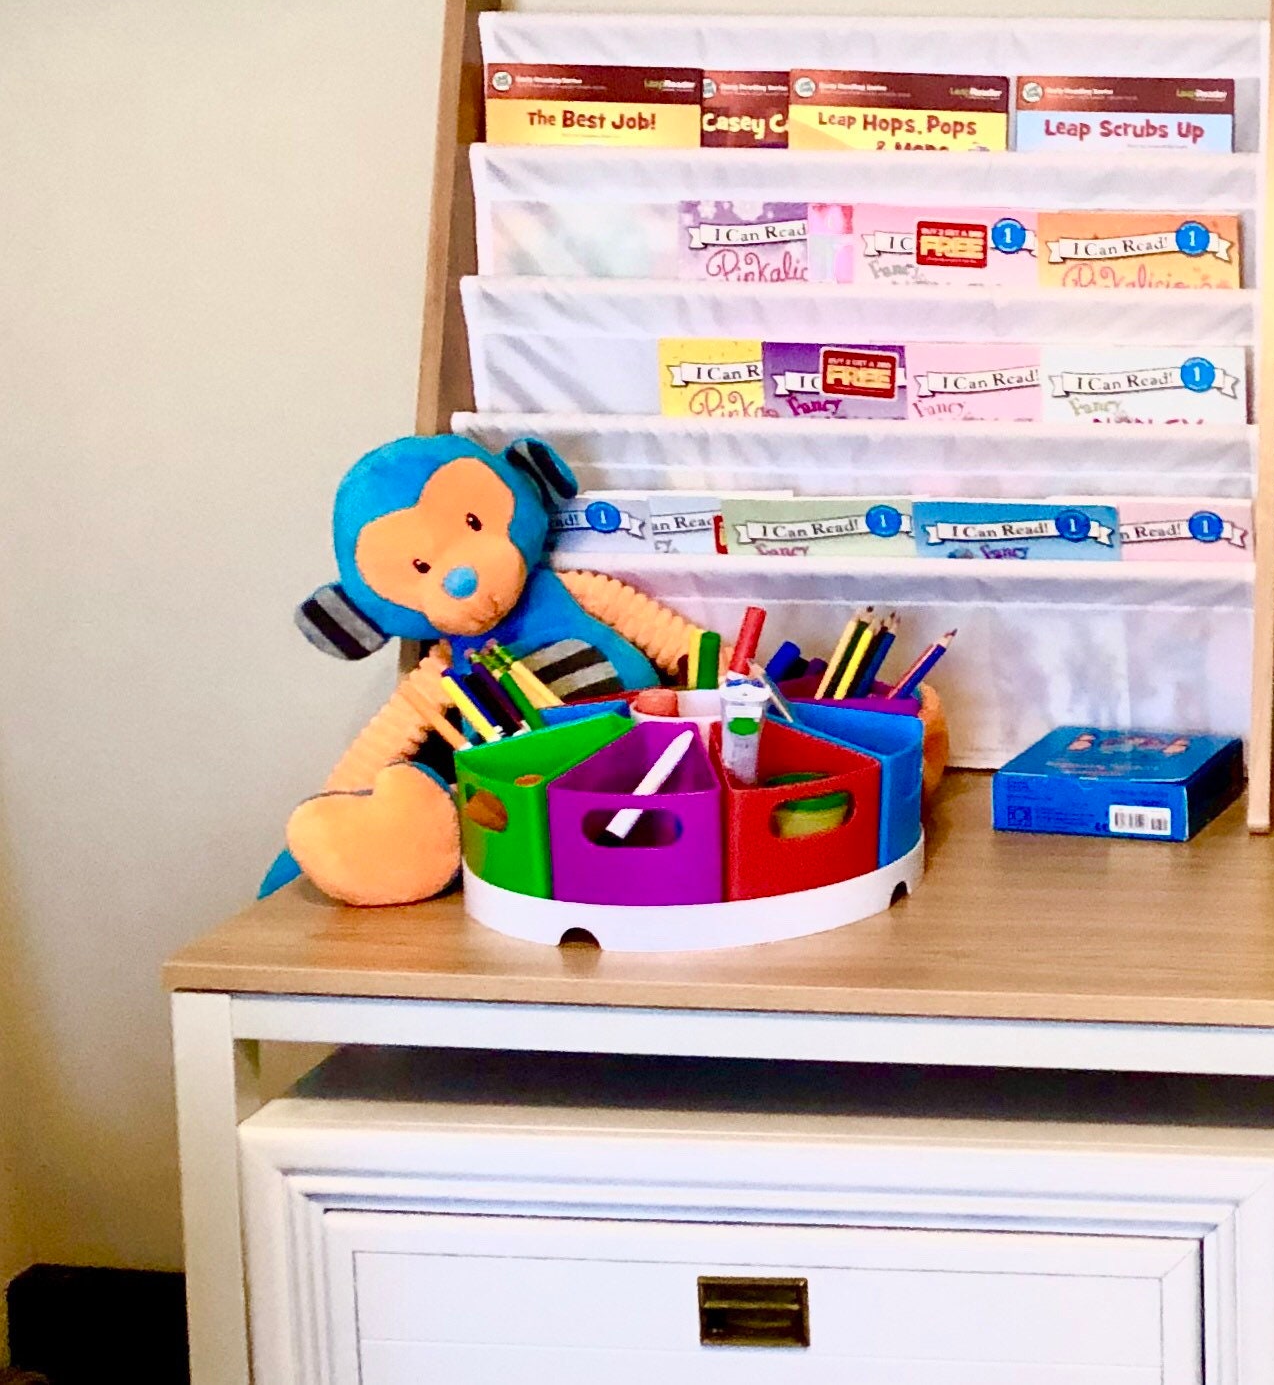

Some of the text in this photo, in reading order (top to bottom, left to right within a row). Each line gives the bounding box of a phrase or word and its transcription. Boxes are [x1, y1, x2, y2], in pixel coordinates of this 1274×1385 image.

[527, 109, 657, 130] The Best Job!
[702, 113, 766, 140] Casey
[818, 112, 857, 130] Leap
[927, 115, 977, 139] Pops
[1044, 119, 1204, 143] Leap Scrubs Up
[714, 228, 720, 242] I
[726, 228, 760, 242] Can
[1003, 227, 1012, 243] 1
[1188, 230, 1196, 246] 1
[920, 235, 984, 259] FREE
[1073, 243, 1078, 256] I
[1084, 242, 1118, 257] Can
[696, 367, 702, 379] I
[707, 367, 741, 380] Can
[826, 365, 892, 389] FREE
[1192, 366, 1200, 382] 1
[943, 377, 948, 389] I
[953, 377, 988, 390] Can
[1077, 377, 1082, 390] I
[1088, 377, 1121, 391] Can
[787, 393, 843, 416] Fancy
[879, 514, 886, 528] 1
[1068, 518, 1076, 532] 1
[1202, 519, 1209, 534] 1
[762, 525, 767, 536] I
[773, 525, 808, 538] Can
[952, 523, 1049, 538] I Can Read!
